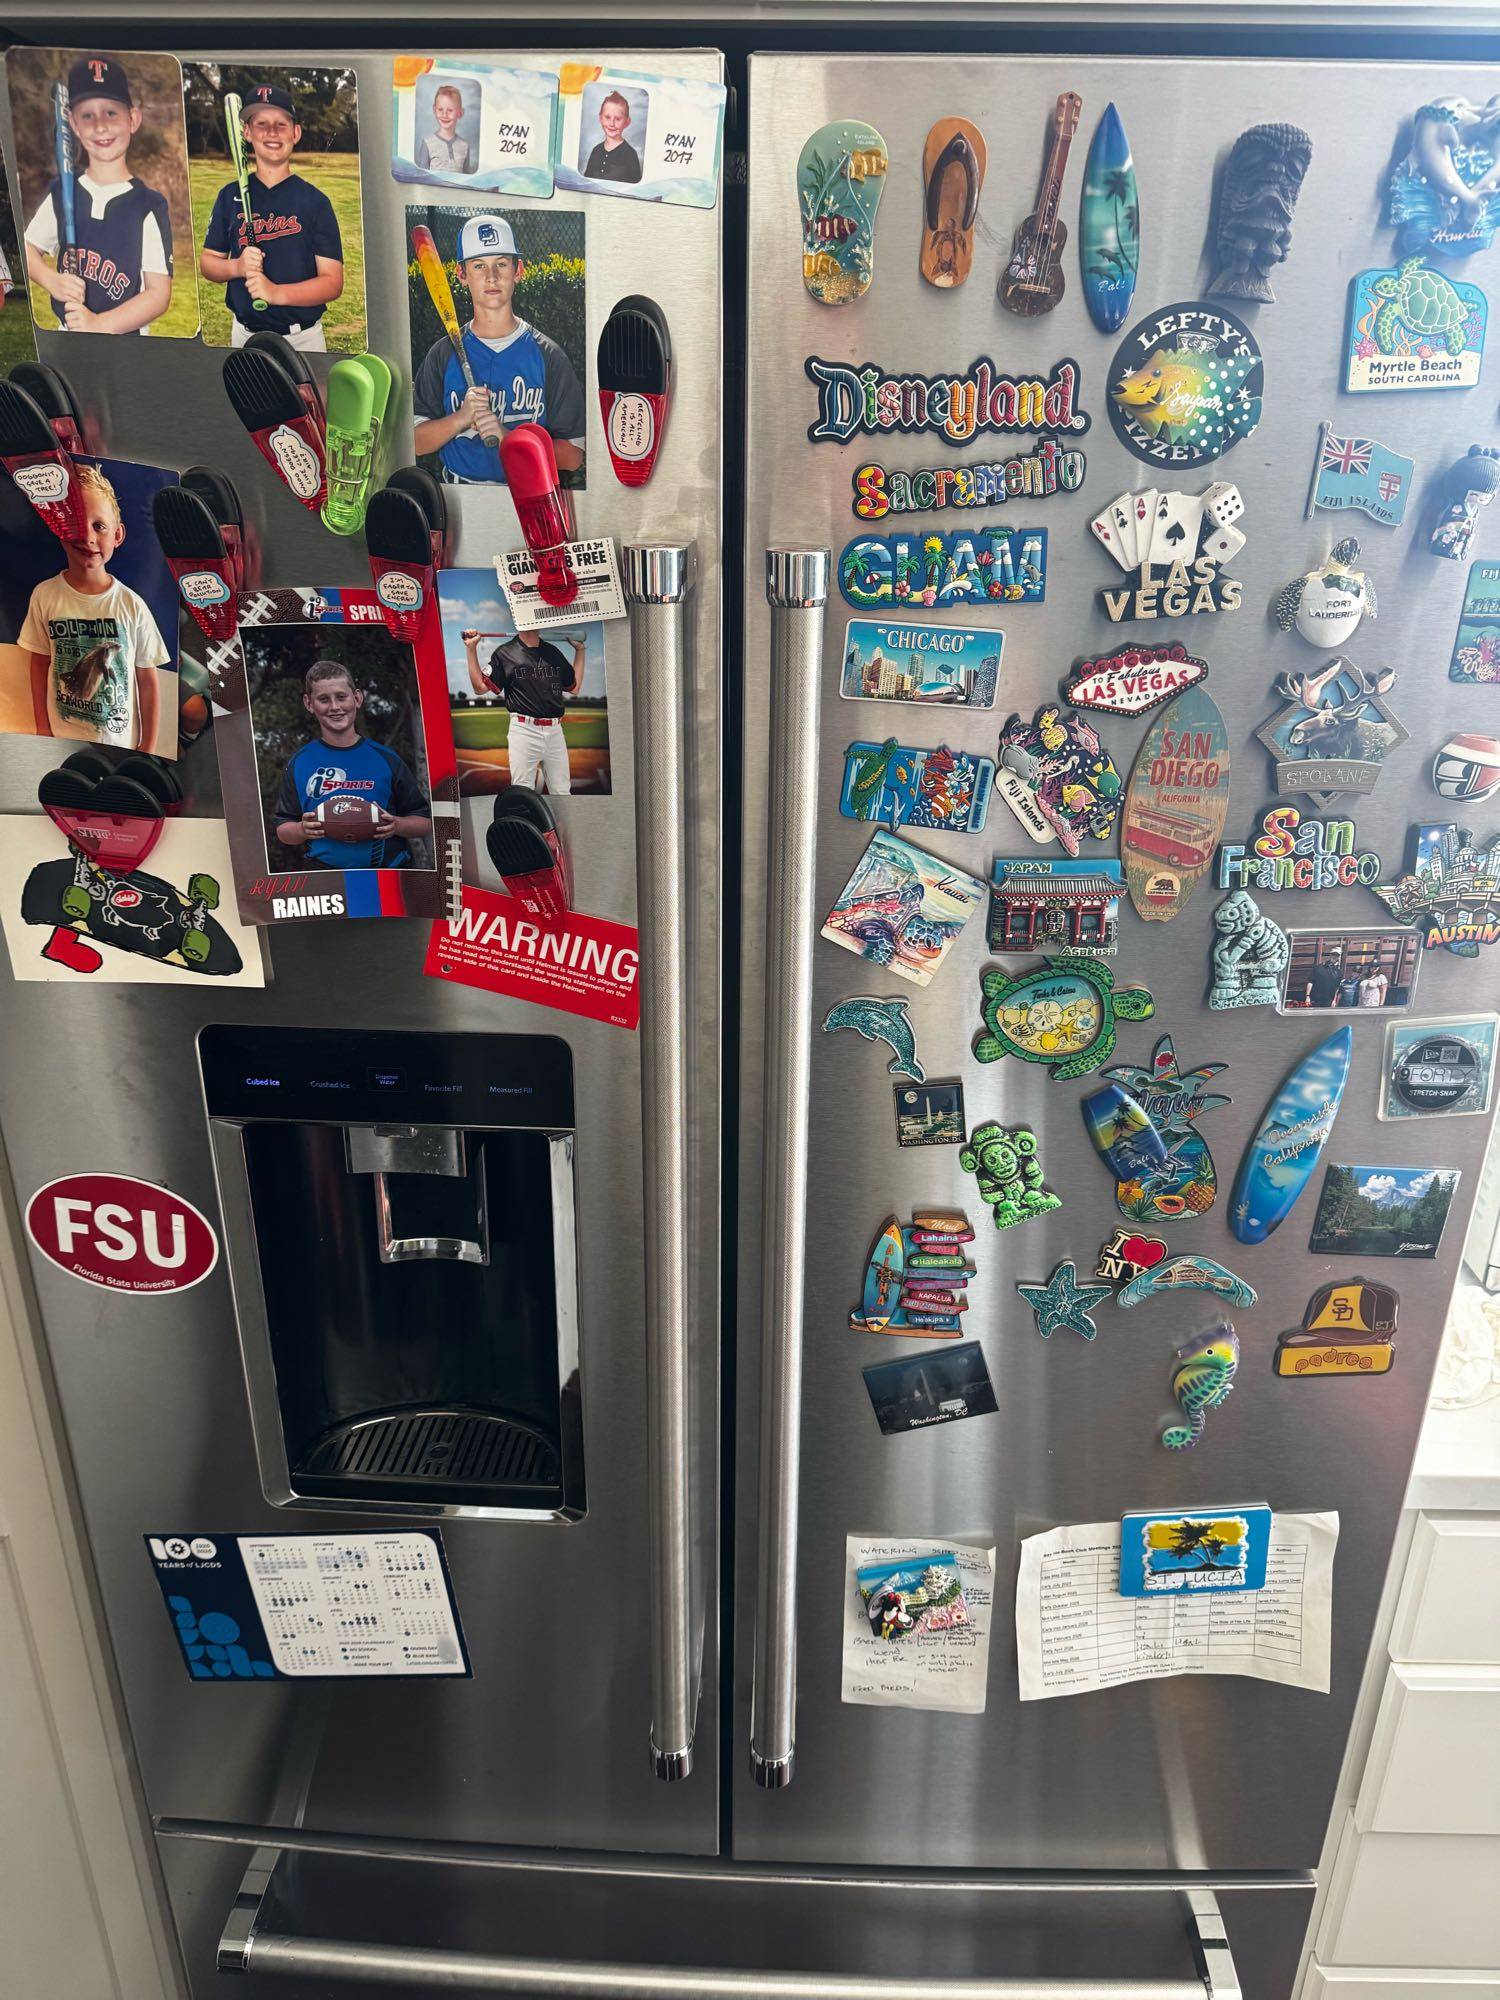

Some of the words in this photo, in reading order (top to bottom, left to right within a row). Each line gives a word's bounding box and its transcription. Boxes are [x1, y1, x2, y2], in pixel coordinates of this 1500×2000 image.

[88, 59, 108, 83] T
[256, 86, 273, 103] T
[499, 123, 530, 139] RYAN
[499, 139, 528, 155] 2016
[664, 133, 696, 149] RYAN
[664, 149, 694, 165] 2017
[1430, 227, 1486, 244] Hawaii
[1137, 311, 1251, 357] LEFTY'S
[1369, 361, 1418, 376] Myrtle
[1420, 359, 1462, 372] Beach
[1368, 375, 1405, 385] SOUTH
[1407, 373, 1461, 383] CAROLINA
[511, 375, 545, 424] Day
[629, 412, 636, 420] IS
[635, 402, 644, 447] RECYCLING
[26, 480, 44, 488] SAVE
[299, 469, 312, 485] LIKE
[855, 440, 1085, 519] Sacramento
[1322, 495, 1343, 507] FIJI
[1349, 495, 1394, 520] ISLANDS
[506, 553, 521, 562] BUY
[522, 552, 528, 560] 2
[572, 544, 585, 554] GET
[587, 542, 593, 551] A
[508, 560, 540, 576] GIAN
[577, 550, 608, 567] FREE
[843, 534, 1044, 605] GUAM
[194, 577, 213, 586] CAN'T
[1141, 556, 1217, 591] LAS
[1481, 568, 1500, 580] FIJ
[188, 588, 222, 598] POLLUTION
[192, 584, 212, 592] BEAR
[386, 594, 415, 602] ENERGY
[1104, 581, 1243, 623] VEGAS
[1326, 600, 1352, 609] FORT
[887, 629, 966, 653] CHICAGO
[1080, 646, 1185, 677] WELCOME
[1093, 676, 1104, 684] TO
[1107, 666, 1161, 683] Fabulous
[1082, 681, 1117, 702] LAS
[1122, 669, 1190, 694] VEGAS
[1110, 691, 1159, 706] NEVADA
[1160, 730, 1213, 760] SAN
[1150, 758, 1220, 789] DIEGO
[1286, 768, 1371, 786] SPOKANE
[322, 779, 375, 791] SPORTS
[1004, 778, 1022, 800] Fiji
[1018, 795, 1046, 832] Islands
[1254, 807, 1357, 858] San
[1004, 862, 1053, 874] JAPAN
[1219, 844, 1382, 892] Francisco
[934, 875, 972, 905] Kauai
[272, 893, 346, 919] RAINES
[1427, 923, 1500, 949] AUSTIN
[449, 907, 639, 984] WARNING
[1060, 945, 1118, 957] Asakusa
[440, 936, 451, 944] Do
[464, 943, 490, 953] remove
[491, 949, 503, 957] this
[504, 952, 519, 961] card
[520, 955, 535, 964] until
[536, 960, 559, 971] Helmet
[567, 968, 589, 979] issued
[597, 978, 618, 989] player,
[619, 983, 633, 992] and
[449, 946, 461, 954] has
[463, 950, 478, 958] read
[479, 953, 492, 961] and
[493, 958, 533, 972] understands
[534, 967, 545, 975] the
[546, 971, 572, 984] warning
[573, 978, 605, 992] statement
[605, 987, 615, 995] on
[615, 990, 626, 998] the
[437, 952, 463, 962] reverse
[463, 958, 478, 966] side
[487, 963, 500, 971] this
[500, 967, 516, 975] card
[516, 971, 530, 979] and
[530, 975, 550, 984] inside
[551, 979, 562, 988] the
[562, 983, 588, 995] Helmet.
[246, 1077, 269, 1086] Cubed
[269, 1078, 281, 1087] Ice
[310, 1080, 339, 1089] Crushed
[424, 1083, 451, 1093] Favorite
[451, 1083, 463, 1092] Fill
[489, 1085, 523, 1095] Measured
[523, 1086, 533, 1095] Fill
[1408, 1088, 1458, 1098] STRETCH-SNAP
[1263, 1127, 1330, 1168] California
[1128, 1154, 1151, 1168] Bali
[53, 1196, 188, 1269] FSU
[930, 1219, 961, 1232] Maui
[920, 1234, 959, 1242] Lahaina
[1106, 1230, 1131, 1257] I
[72, 1262, 105, 1283] Florida
[106, 1275, 131, 1289] State
[132, 1278, 177, 1290] University
[1095, 1256, 1152, 1283] NY
[918, 1291, 953, 1303] KAPALUA
[1331, 1297, 1354, 1322] SD
[1295, 1347, 1374, 1374] padres
[954, 1406, 969, 1417] DC
[157, 1561, 186, 1569] YEARS
[186, 1561, 194, 1569] of
[1145, 1573, 1176, 1586] ST.
[1183, 1570, 1243, 1583] LUCIA
